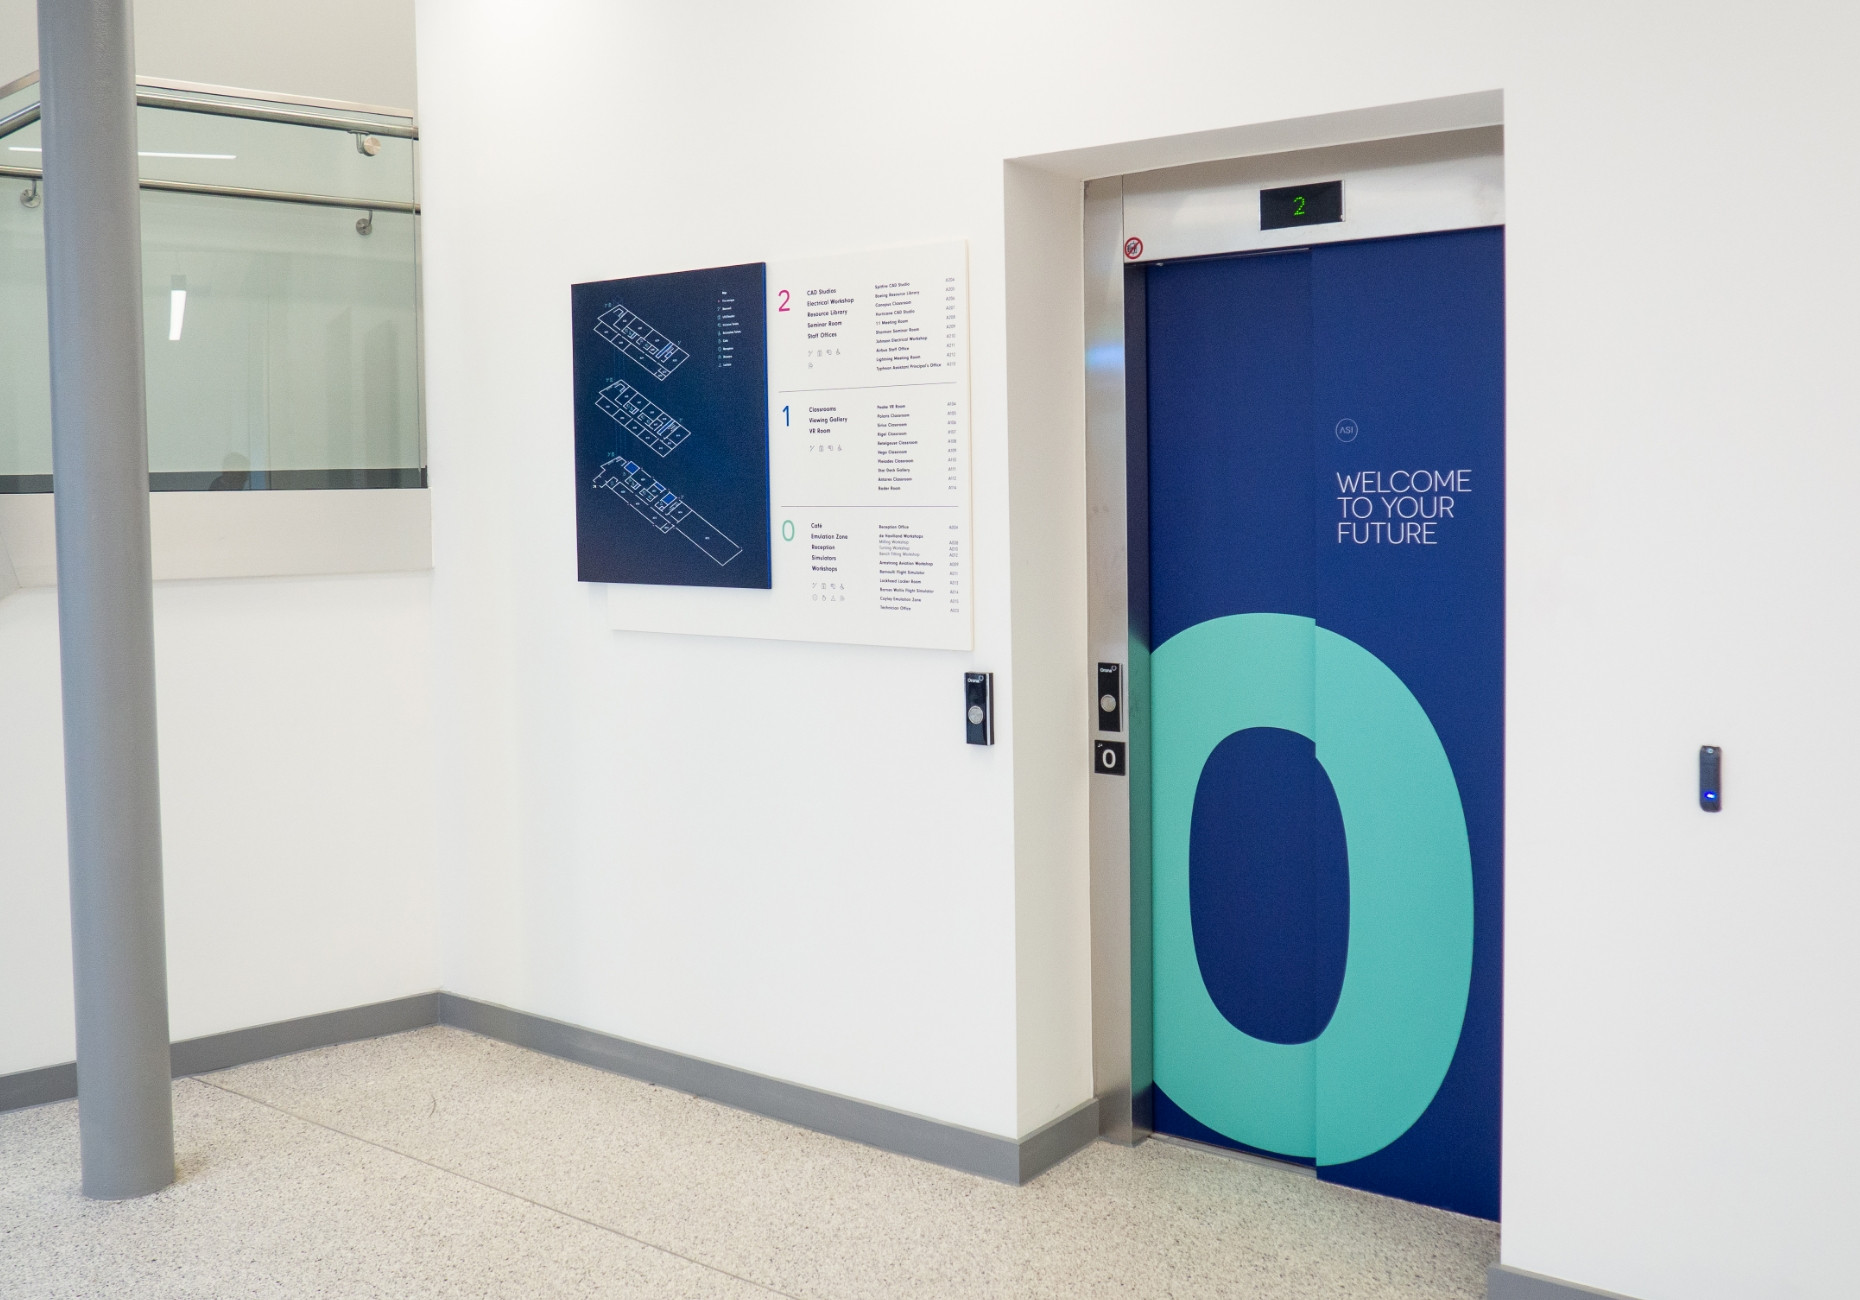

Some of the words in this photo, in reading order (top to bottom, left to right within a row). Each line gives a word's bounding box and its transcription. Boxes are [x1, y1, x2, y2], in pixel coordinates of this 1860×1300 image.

[1294, 196, 1305, 216] 2
[778, 290, 790, 312] 2
[782, 406, 789, 426] 1
[1336, 469, 1472, 493] WELCOME
[1337, 496, 1372, 518] TO
[1381, 496, 1455, 518] YOUR
[782, 520, 794, 541] 0
[1338, 522, 1438, 544] FUTURE
[1102, 749, 1116, 768] 0
[1151, 612, 1474, 1166] 0
